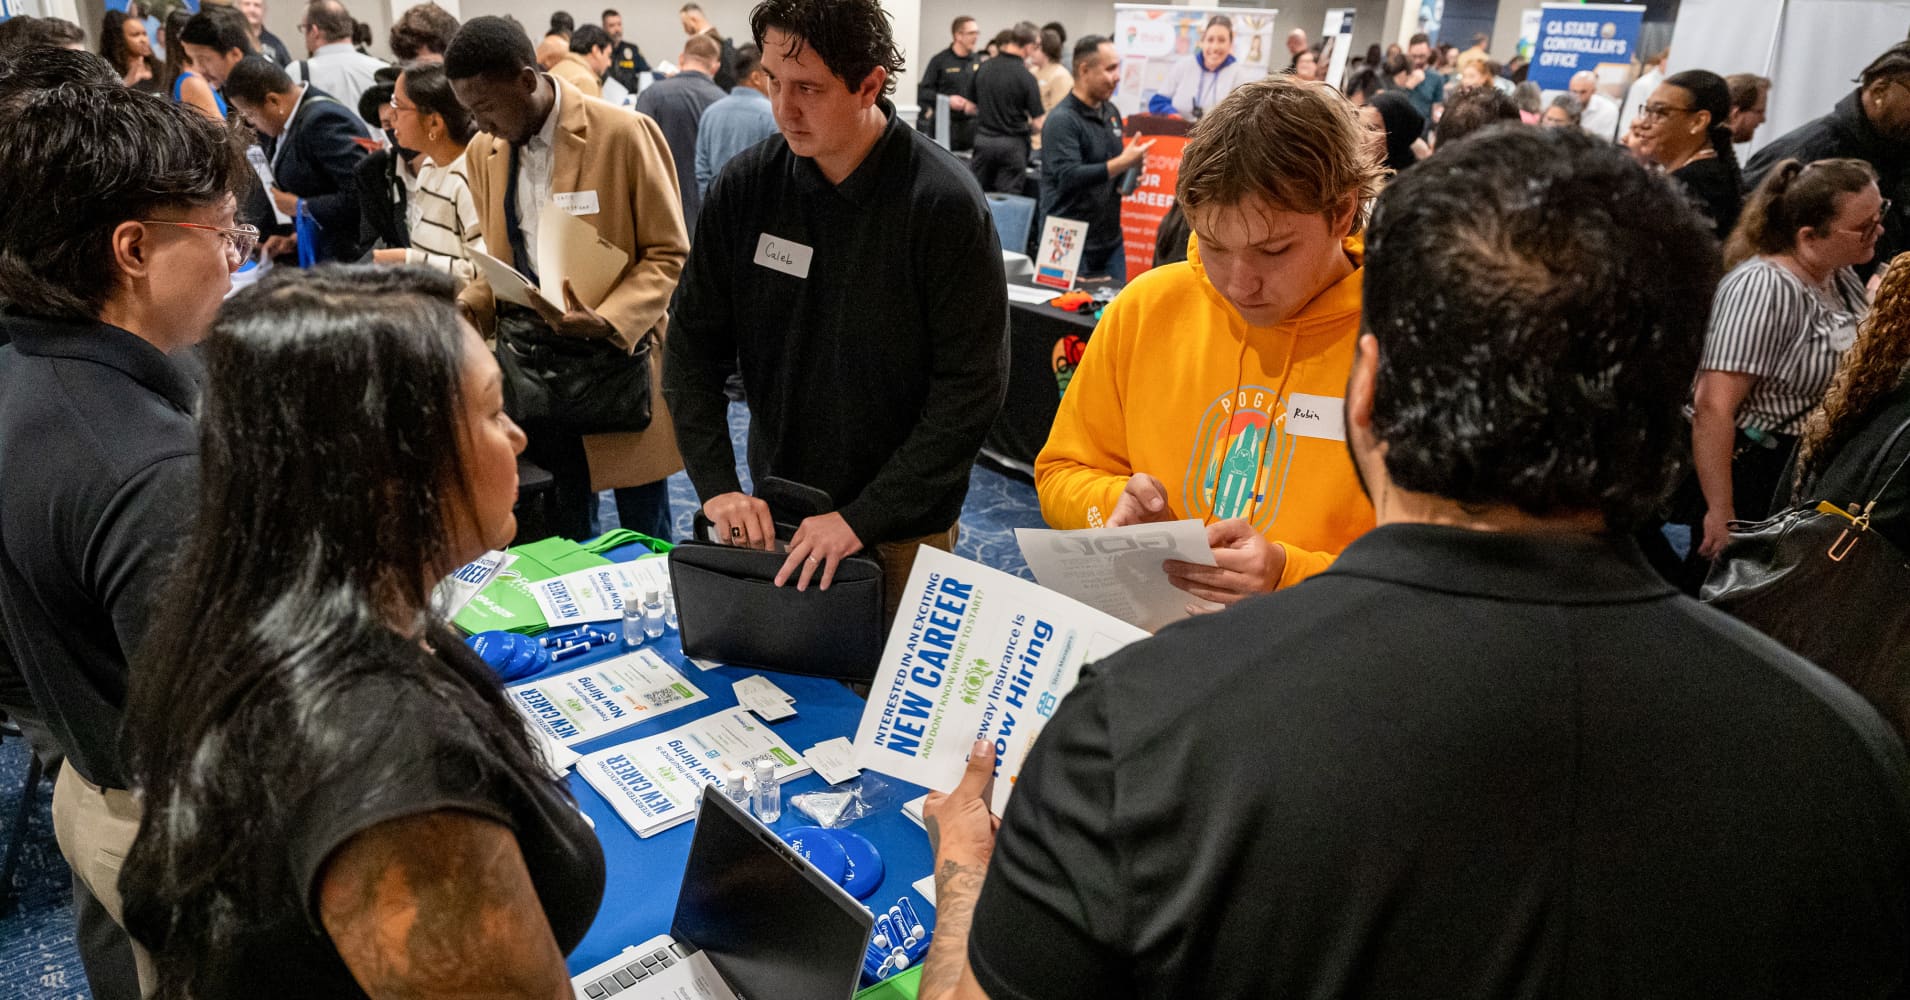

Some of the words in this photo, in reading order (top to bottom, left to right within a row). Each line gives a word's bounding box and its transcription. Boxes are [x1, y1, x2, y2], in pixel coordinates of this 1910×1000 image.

[1546, 20, 1562, 35] CA
[1564, 22, 1598, 36] STATE
[1543, 36, 1626, 54] CONTROLLER'S
[1540, 52, 1578, 68] OFFICE
[766, 242, 792, 264] Caleb
[912, 572, 940, 630] EXCITING
[906, 632, 920, 652] AN
[887, 690, 934, 757] NEW
[911, 576, 974, 688] CAREER
[901, 652, 913, 668] IN
[988, 627, 1020, 700] Insurance
[1012, 613, 1026, 627] is
[1006, 619, 1054, 709] Hiring
[922, 740, 934, 759] AND
[938, 678, 955, 708] KNOW
[948, 642, 967, 678] WHERE
[962, 626, 972, 640] TO
[967, 589, 984, 626] START?
[577, 676, 607, 701] Hiring
[519, 688, 561, 720] CAREER
[601, 699, 627, 720] Now
[874, 668, 908, 746] INTERESTED
[548, 718, 580, 740] NEW
[661, 750, 686, 773] Insurance
[666, 741, 702, 768] Hiring
[605, 754, 653, 793] CAREER
[625, 790, 654, 817] INTERESTED
[639, 791, 675, 815] NEW
